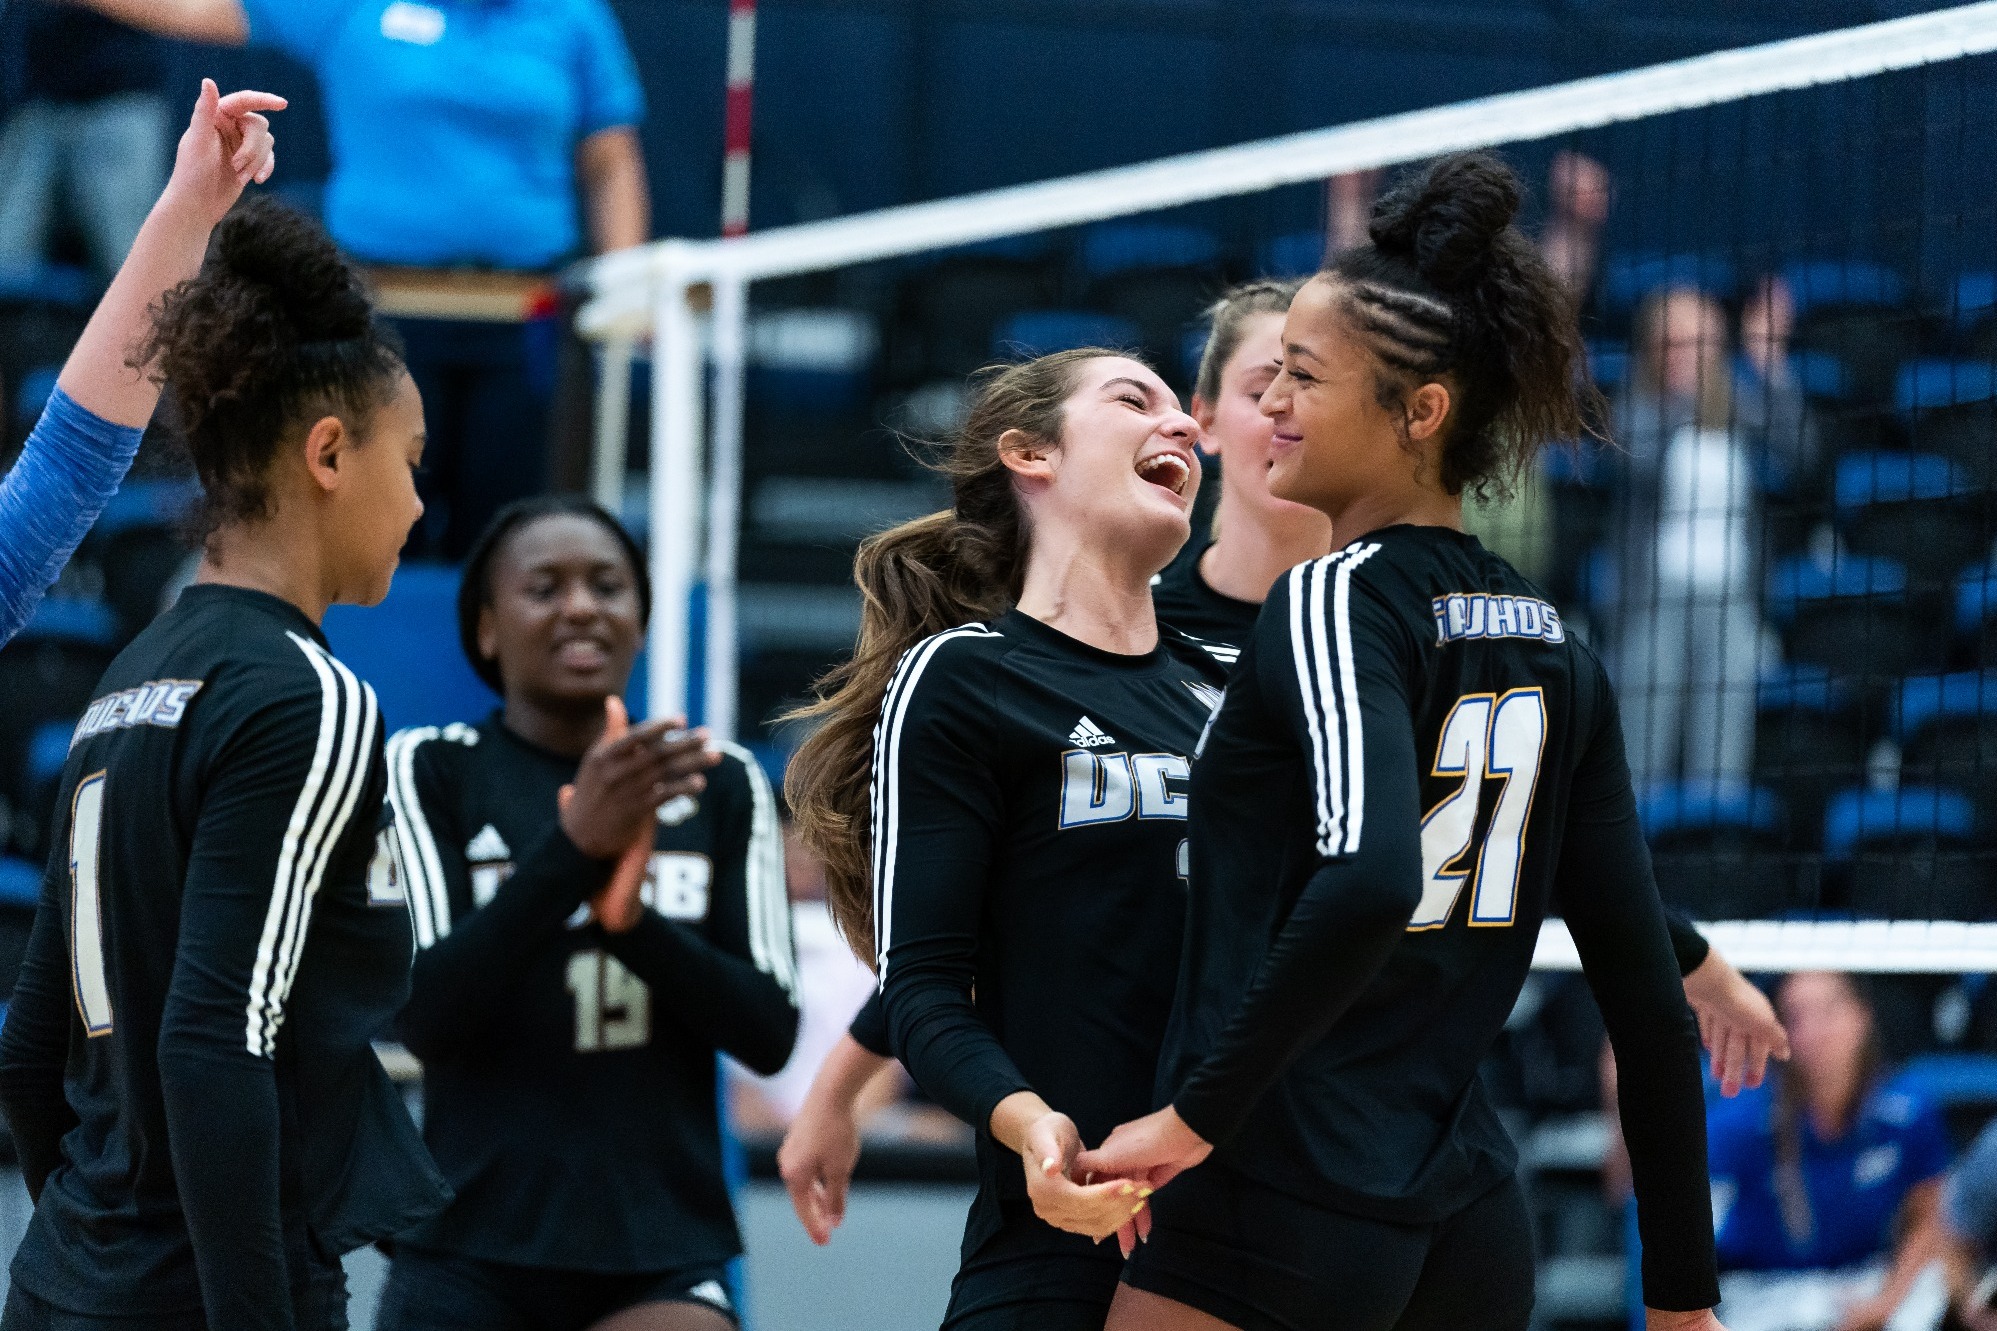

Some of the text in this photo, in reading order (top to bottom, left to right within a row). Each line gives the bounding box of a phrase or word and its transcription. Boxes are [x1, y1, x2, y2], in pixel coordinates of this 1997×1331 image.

[1058, 749, 1191, 830] UC
[69, 768, 114, 1038] 1
[564, 949, 652, 1051] 15
